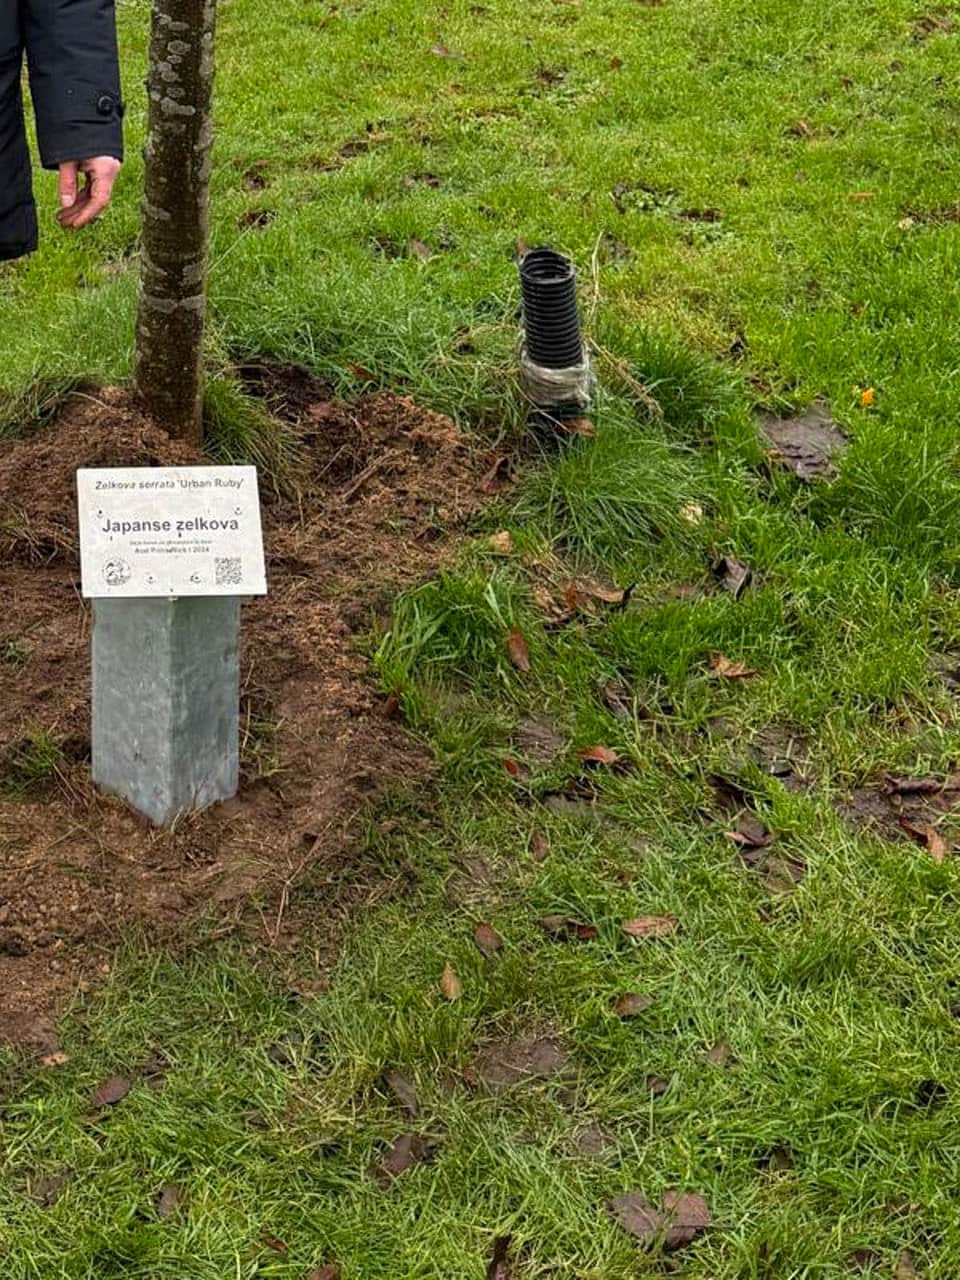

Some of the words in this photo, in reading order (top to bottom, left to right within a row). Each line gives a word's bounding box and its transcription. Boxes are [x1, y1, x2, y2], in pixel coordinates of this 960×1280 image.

[95, 480, 136, 491] Zelkova
[139, 479, 175, 490] serrata
[102, 518, 171, 535] Japanse
[176, 517, 239, 531] zelkova
